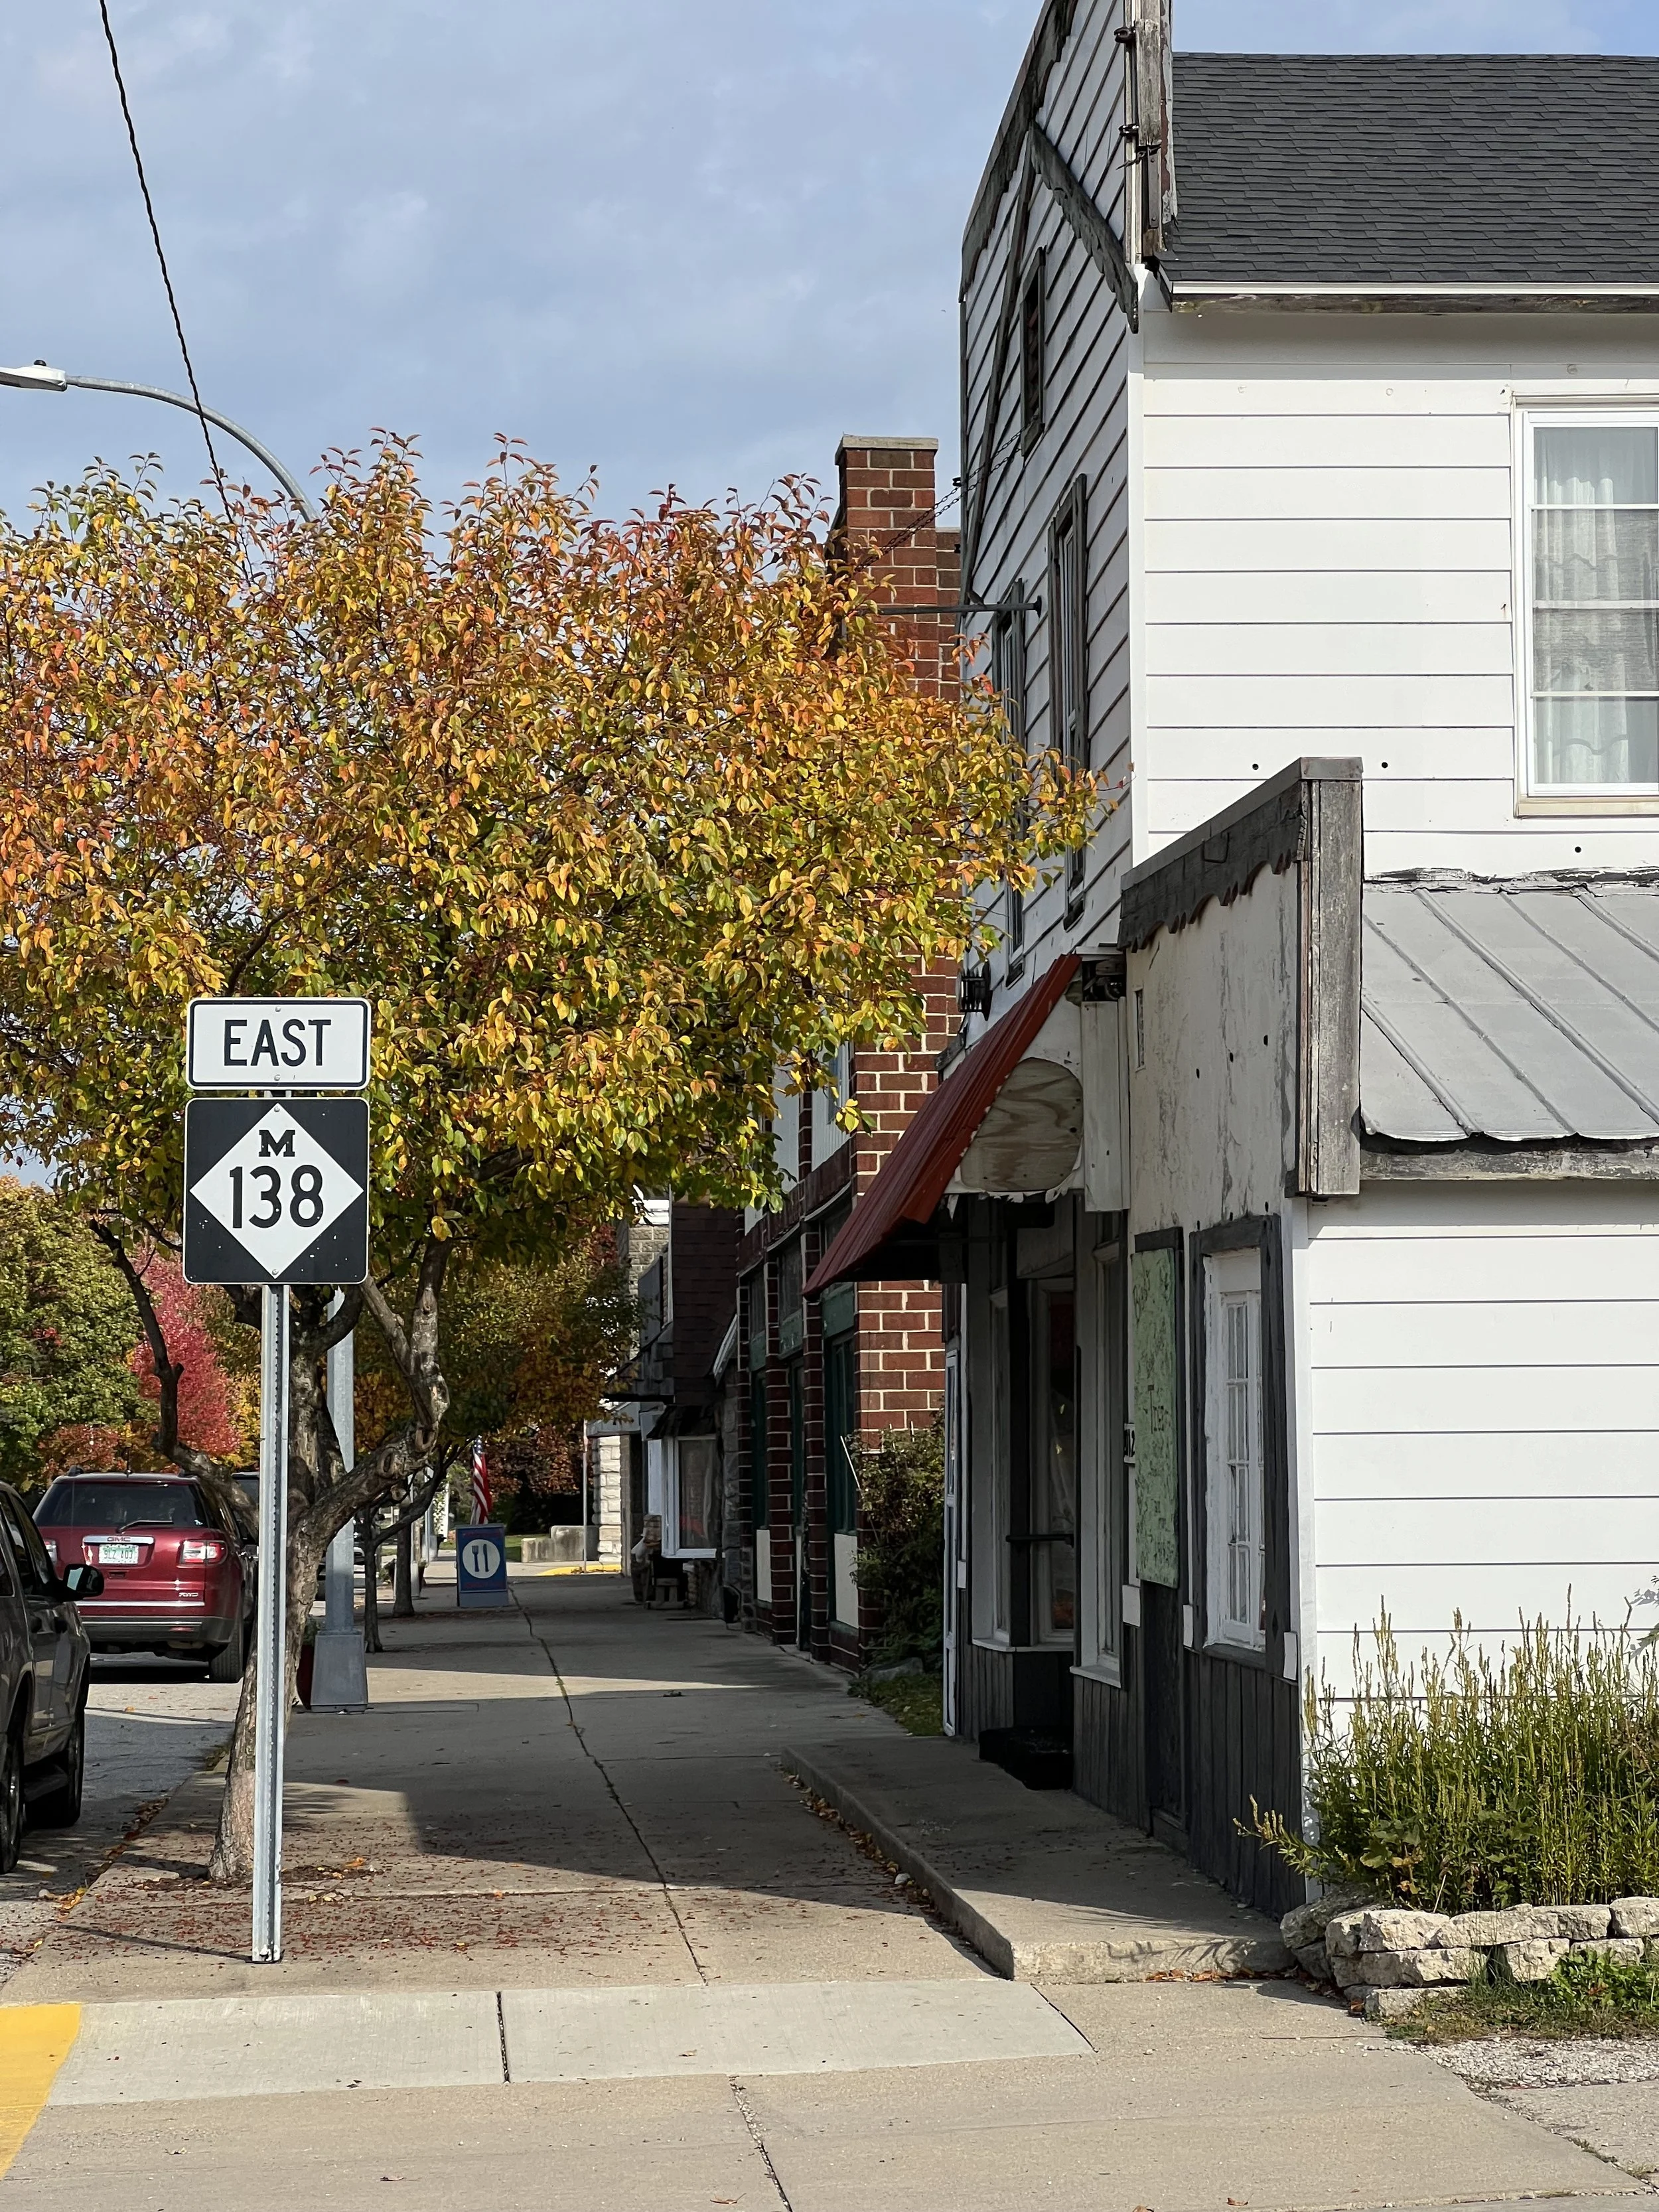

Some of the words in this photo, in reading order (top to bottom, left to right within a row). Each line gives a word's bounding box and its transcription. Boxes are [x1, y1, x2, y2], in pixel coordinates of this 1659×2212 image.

[224, 1019, 332, 1067] EAST
[258, 1130, 296, 1157] M
[229, 1164, 325, 1229] 138
